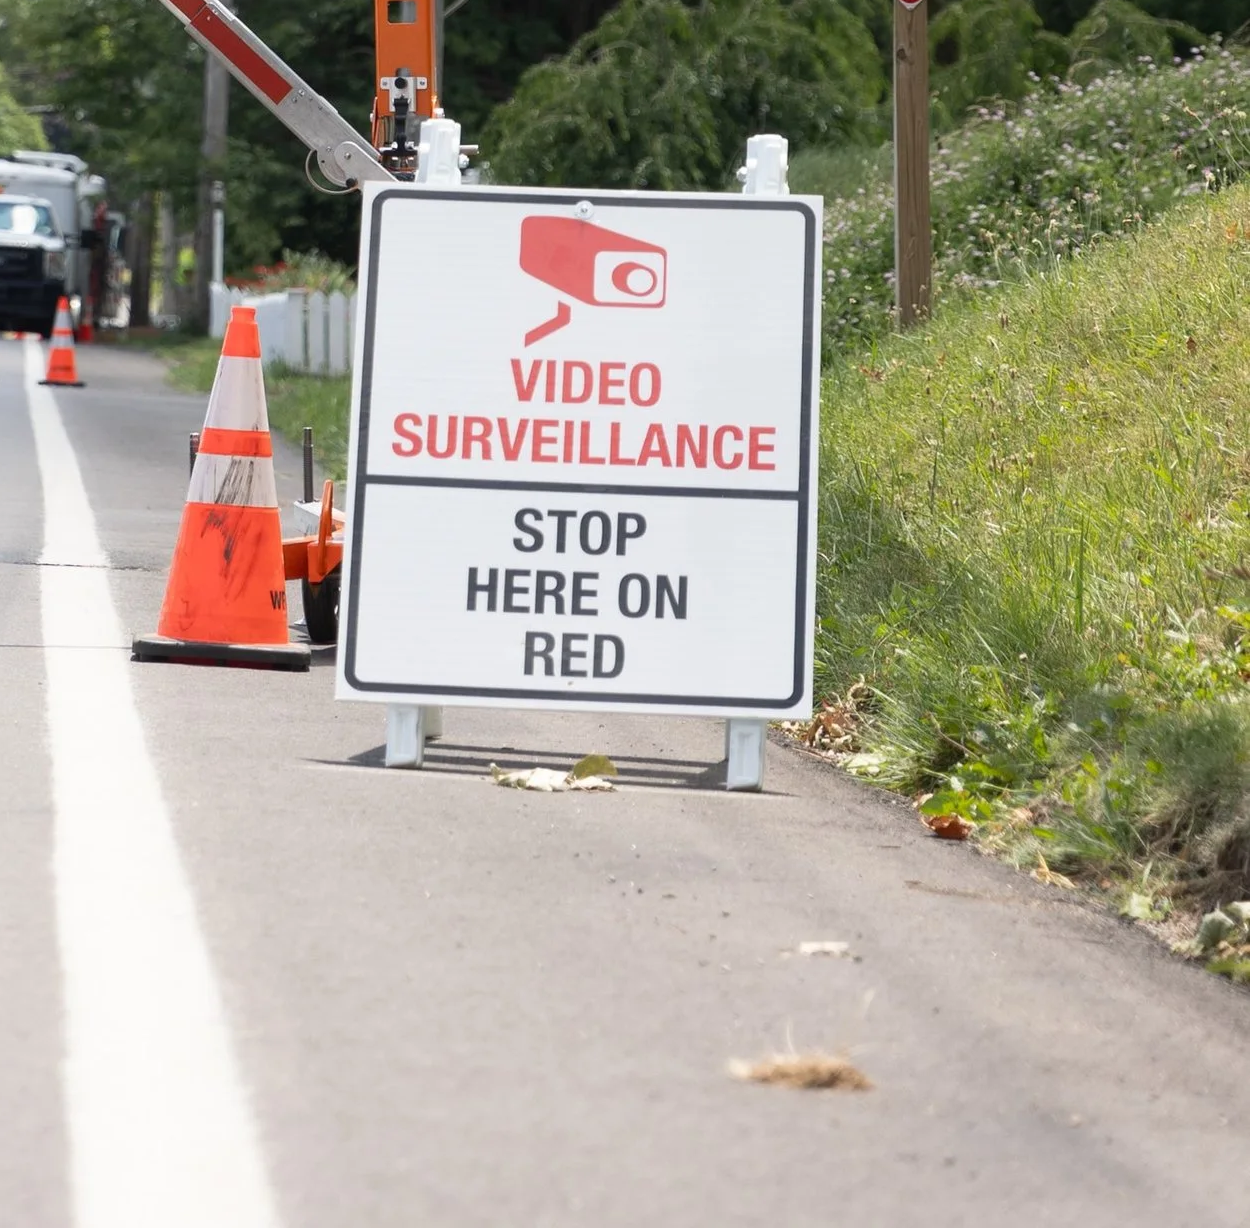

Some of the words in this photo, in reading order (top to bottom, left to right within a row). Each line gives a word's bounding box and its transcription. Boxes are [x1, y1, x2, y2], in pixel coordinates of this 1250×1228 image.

[510, 358, 662, 407] VIDEO
[391, 413, 776, 471] SURVEILLANCE
[513, 507, 647, 556] STOP
[466, 567, 598, 616] HERE
[618, 573, 688, 620] ON
[524, 631, 625, 679] RED
